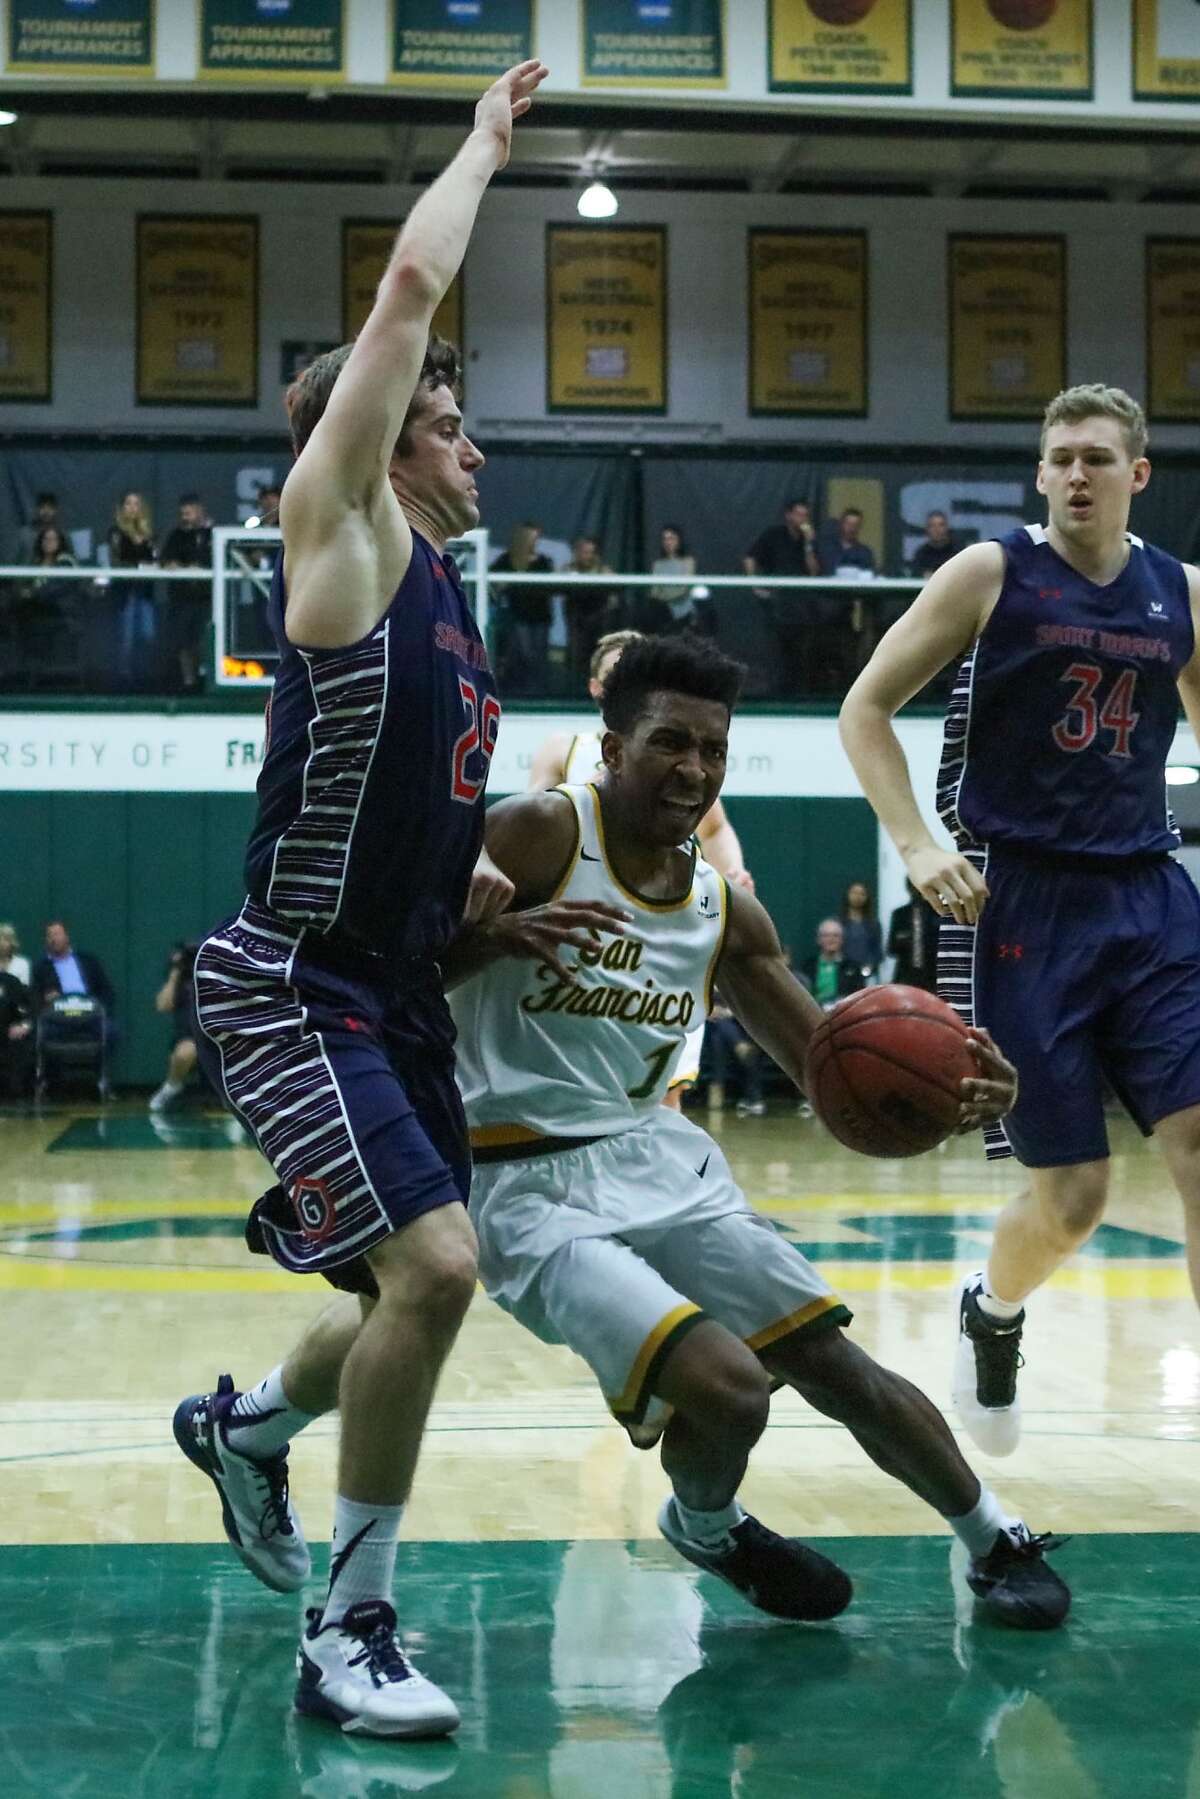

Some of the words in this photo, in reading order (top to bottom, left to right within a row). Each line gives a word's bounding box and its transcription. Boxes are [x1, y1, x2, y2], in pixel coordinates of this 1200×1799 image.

[20, 20, 143, 37] TOURNAMENT
[211, 25, 334, 42] TOURNAMENT
[17, 37, 143, 56] APPEARANCES
[402, 30, 524, 48] TOURNAMENT
[594, 33, 714, 51] TOURNAMENT
[208, 44, 335, 62] APPEARANCES
[400, 49, 525, 68] APPEARANCES
[591, 52, 715, 69] APPEARANCES
[1052, 663, 1140, 760] 34
[131, 741, 178, 768] OF
[522, 962, 696, 1028] Francisco
